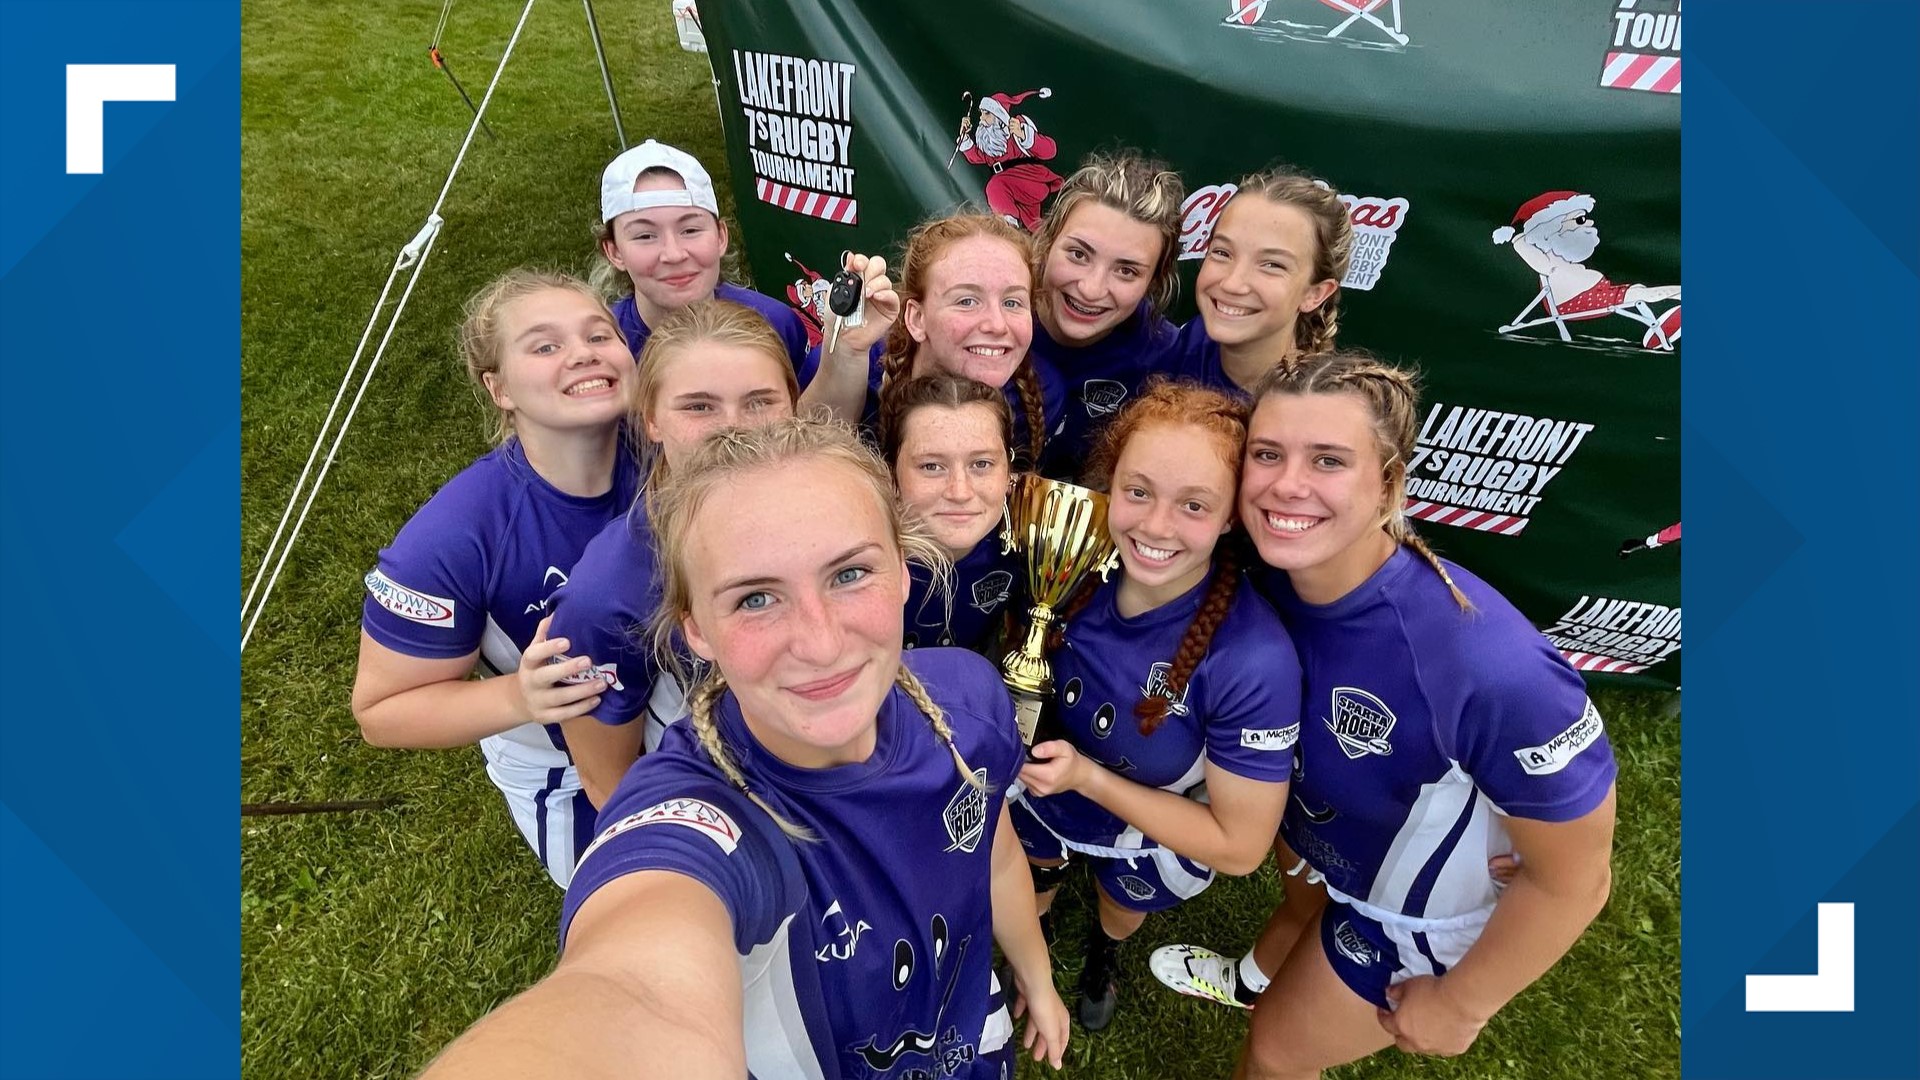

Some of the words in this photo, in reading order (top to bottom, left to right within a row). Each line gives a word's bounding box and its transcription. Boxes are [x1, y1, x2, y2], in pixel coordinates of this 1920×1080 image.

[733, 49, 856, 122] LAKEFRONT
[750, 147, 855, 195] TOURNAMENT
[1350, 260, 1380, 274] GBY
[1416, 402, 1595, 465] LAKEFRONT
[1406, 476, 1543, 516] OURNAMENT
[1560, 595, 1681, 641] LAKEFRO
[1542, 633, 1666, 666] OURNAMENT
[1336, 709, 1382, 737] ROCK
[1338, 696, 1388, 728] SPARTA
[1548, 719, 1590, 753] Michigan
